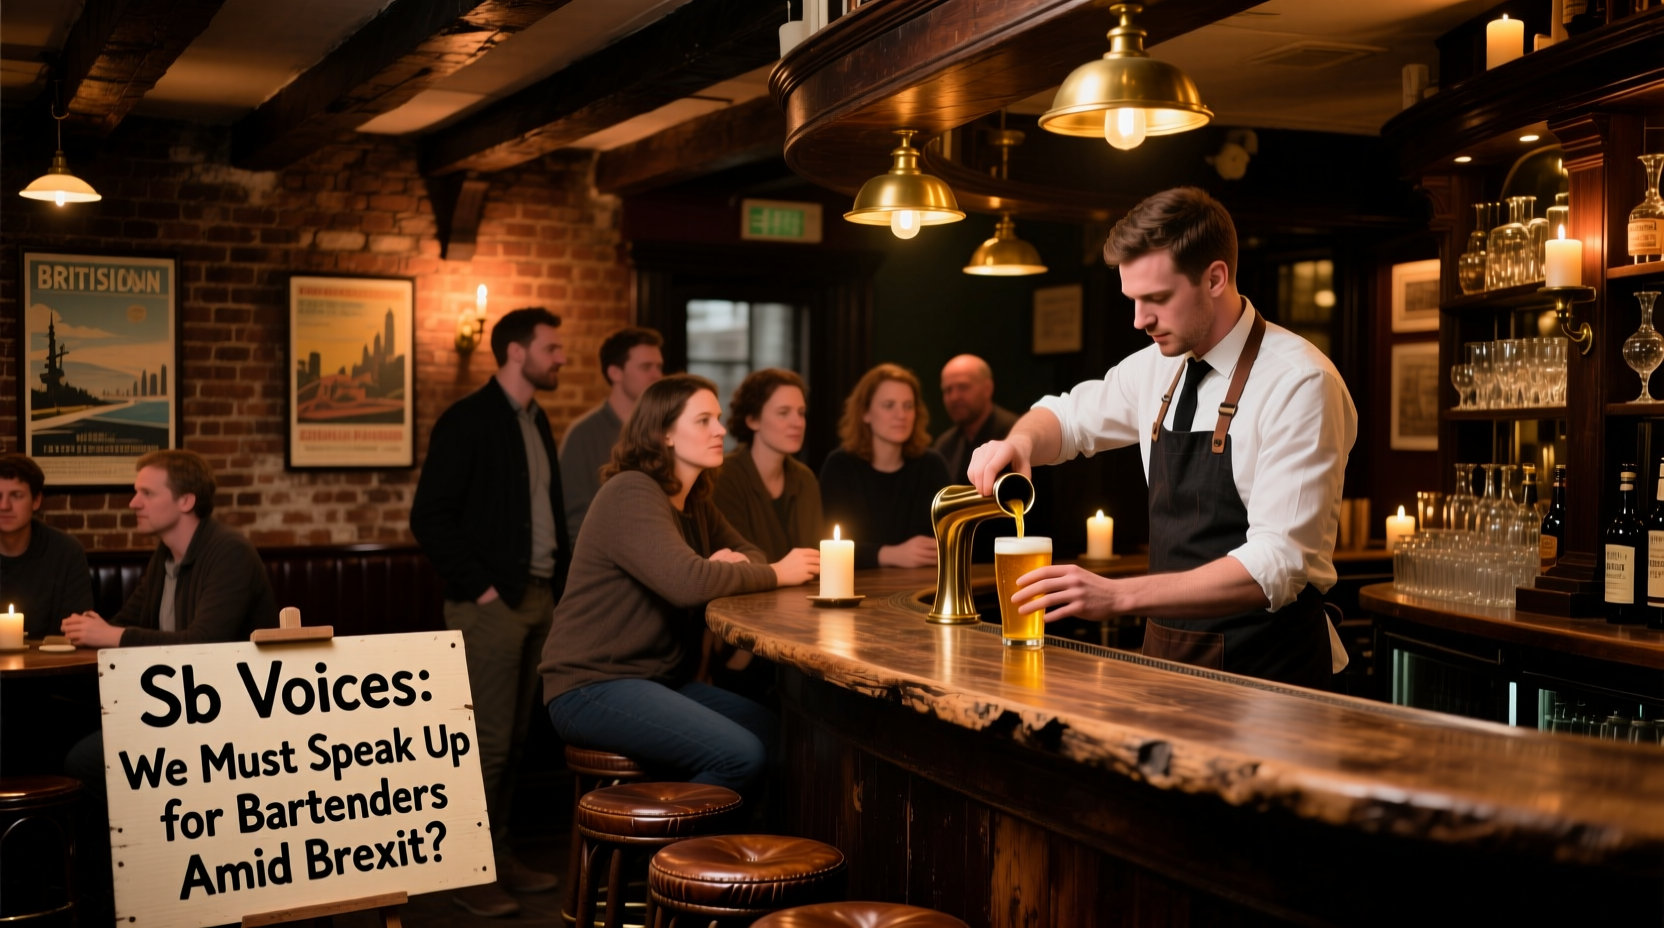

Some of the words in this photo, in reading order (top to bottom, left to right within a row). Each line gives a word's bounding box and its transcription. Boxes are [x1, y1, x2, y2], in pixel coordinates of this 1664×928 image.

[140, 664, 221, 727] Sb
[237, 661, 432, 718] Voices:
[119, 748, 188, 790] We
[200, 741, 298, 783] Must
[308, 727, 416, 781] Speak
[424, 724, 470, 767] Up
[160, 798, 223, 841] for
[237, 778, 448, 833] Bartenders
[180, 842, 292, 900] Amid
[305, 821, 447, 880] Brexit?
